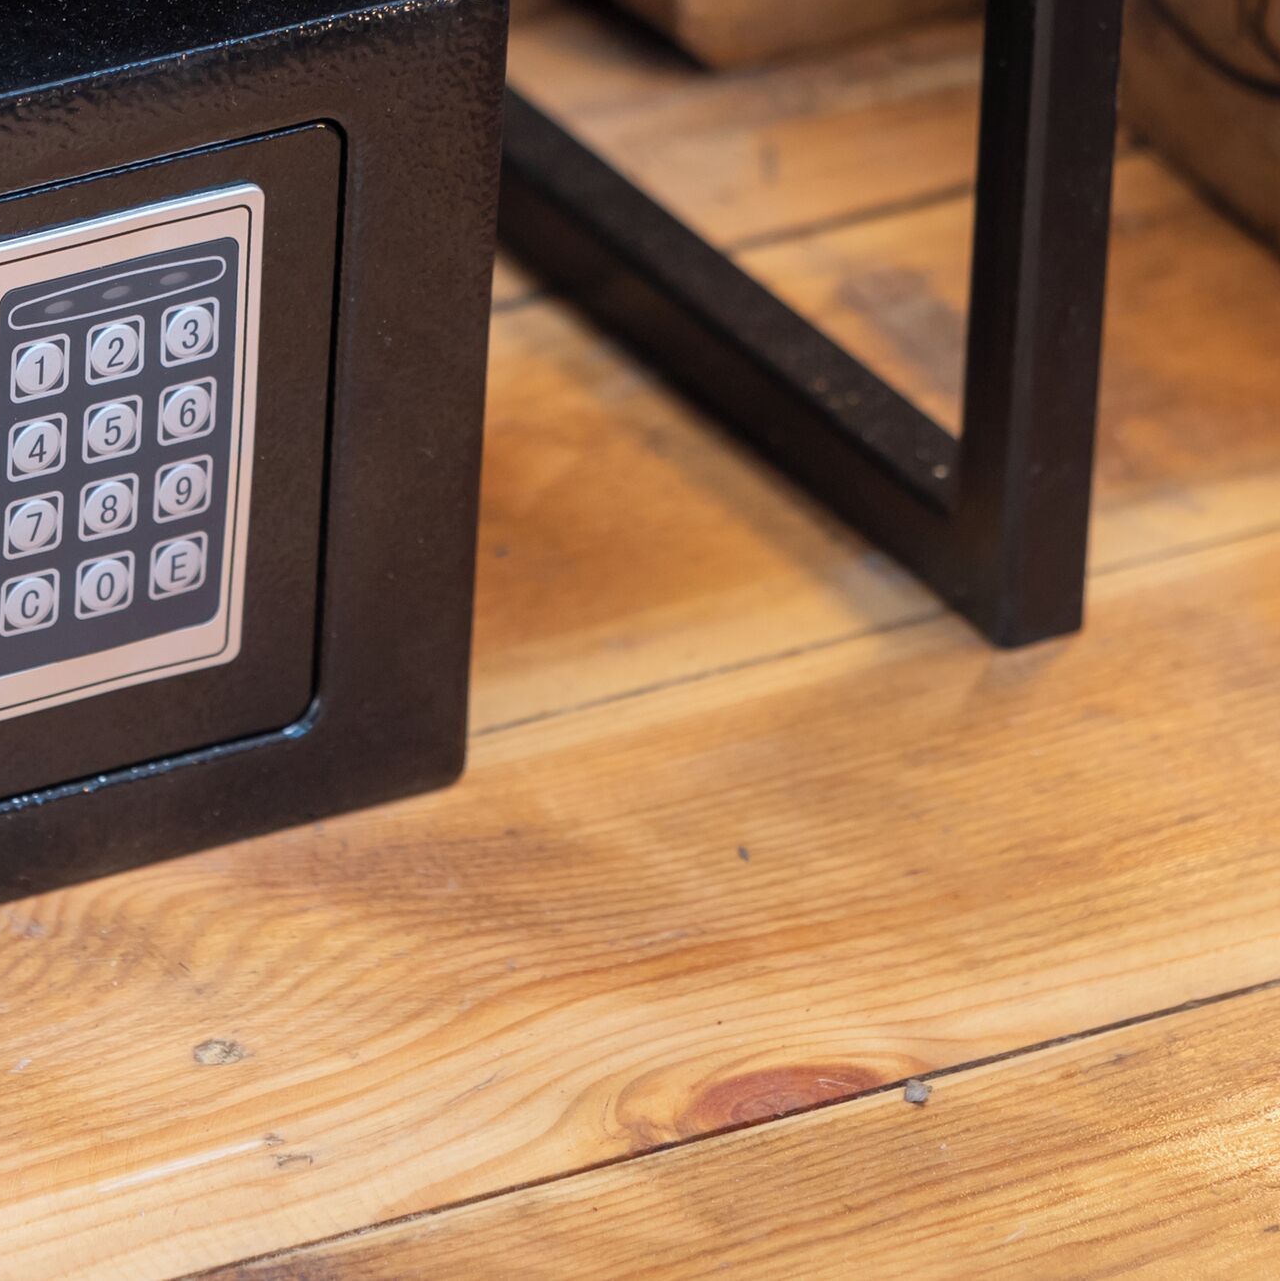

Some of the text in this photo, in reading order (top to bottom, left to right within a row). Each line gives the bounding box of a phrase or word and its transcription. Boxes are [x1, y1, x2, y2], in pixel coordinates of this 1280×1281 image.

[34, 318, 200, 385] 1 2 3
[27, 397, 197, 464] 4 5 6
[26, 476, 193, 542] 7 8 9
[20, 551, 189, 619] C 0 E
